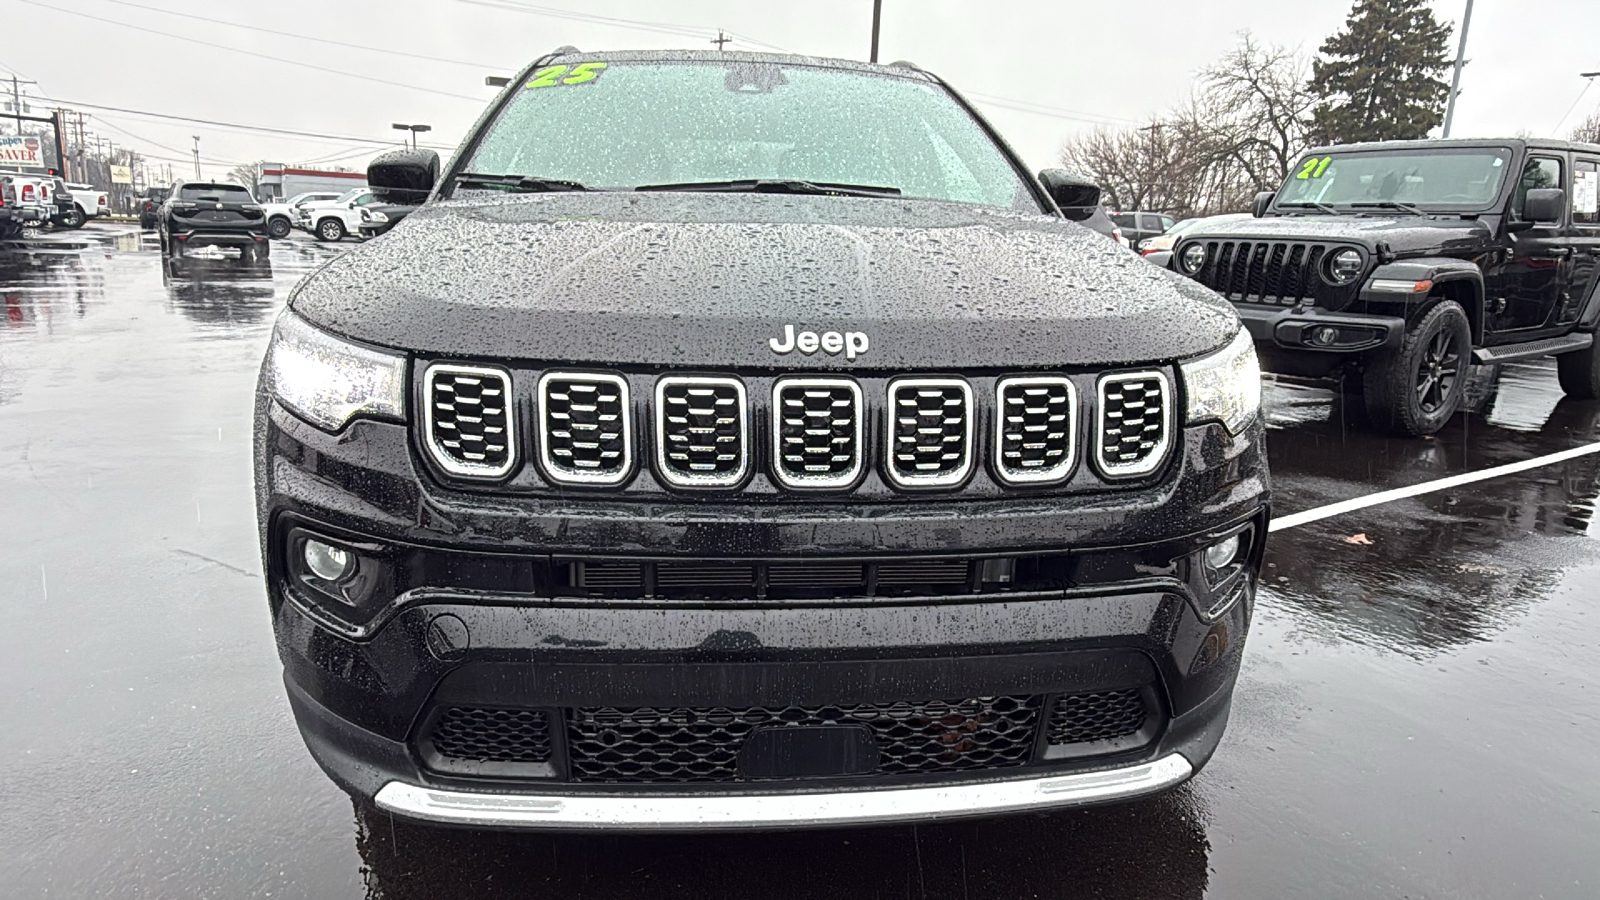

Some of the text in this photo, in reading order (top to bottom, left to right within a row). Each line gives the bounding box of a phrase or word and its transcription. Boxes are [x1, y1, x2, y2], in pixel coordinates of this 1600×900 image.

[526, 62, 608, 88] 25
[1297, 156, 1332, 179] 21
[769, 324, 869, 359] Jeep
